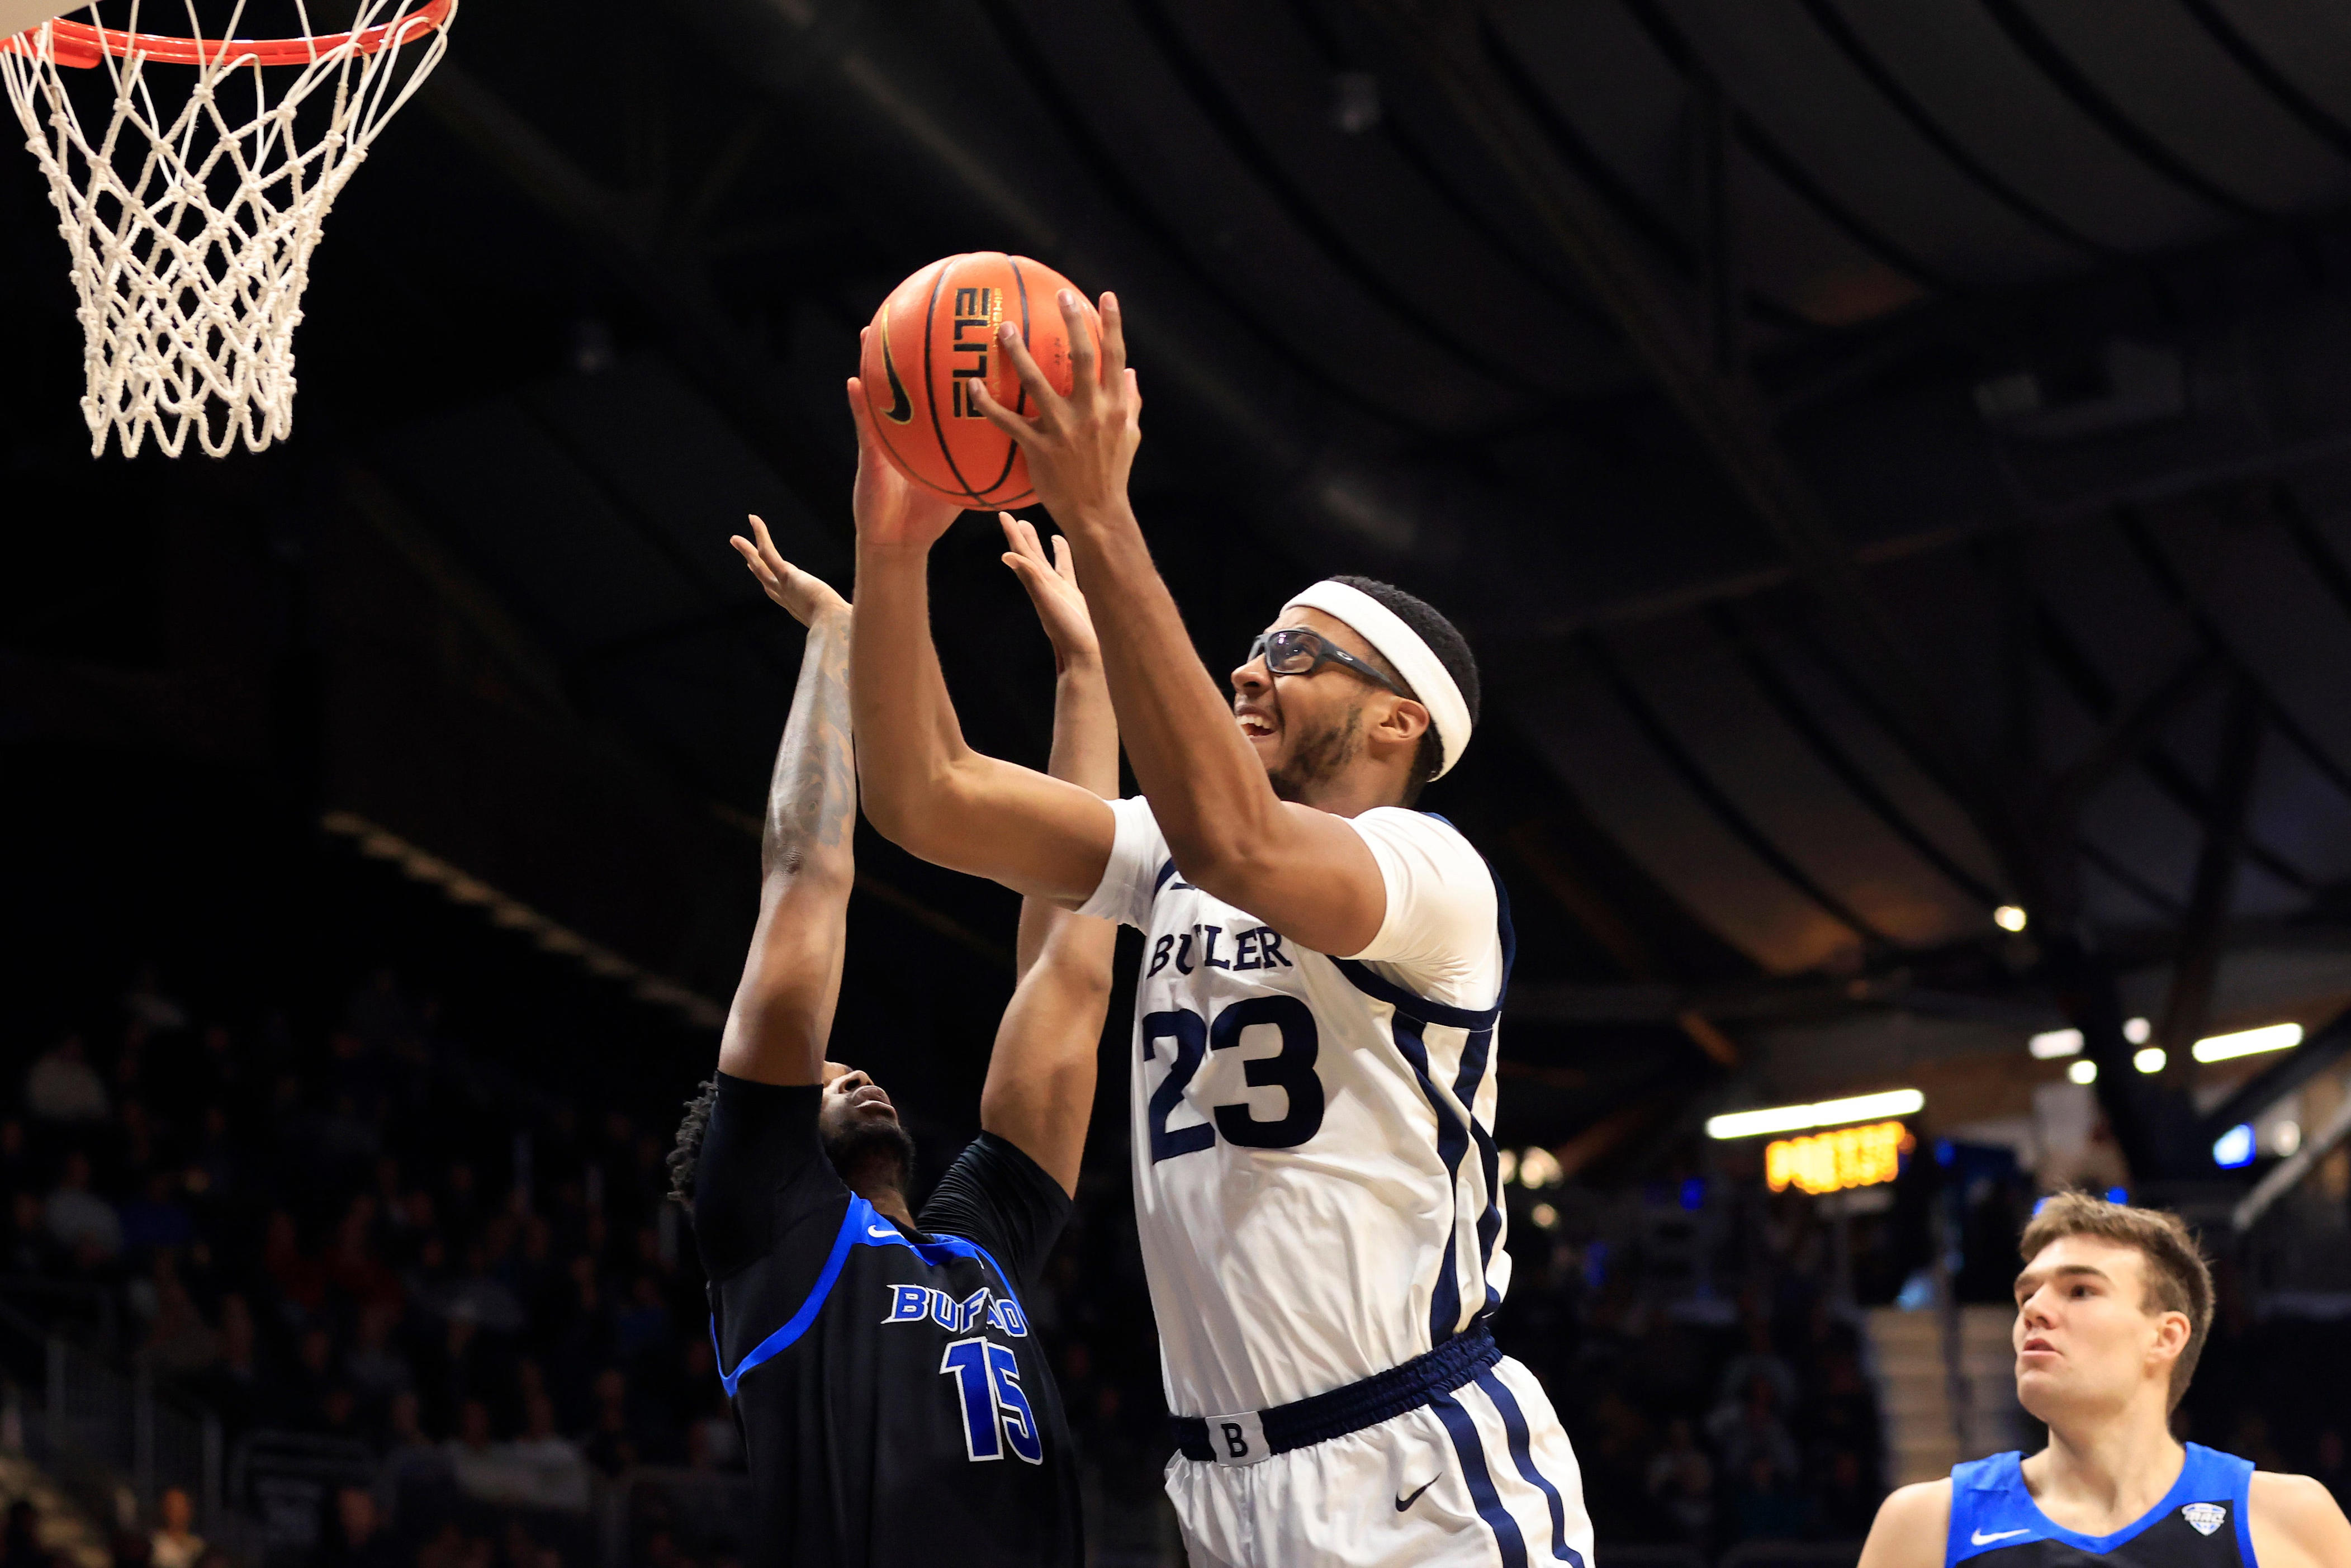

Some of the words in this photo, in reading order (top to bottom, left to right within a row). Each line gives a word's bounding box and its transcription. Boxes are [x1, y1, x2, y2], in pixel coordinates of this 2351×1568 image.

[1146, 924, 1293, 980] BULER
[1142, 994, 1325, 1166] 23
[939, 1336, 1043, 1466] 15
[1221, 1422, 1248, 1458] B
